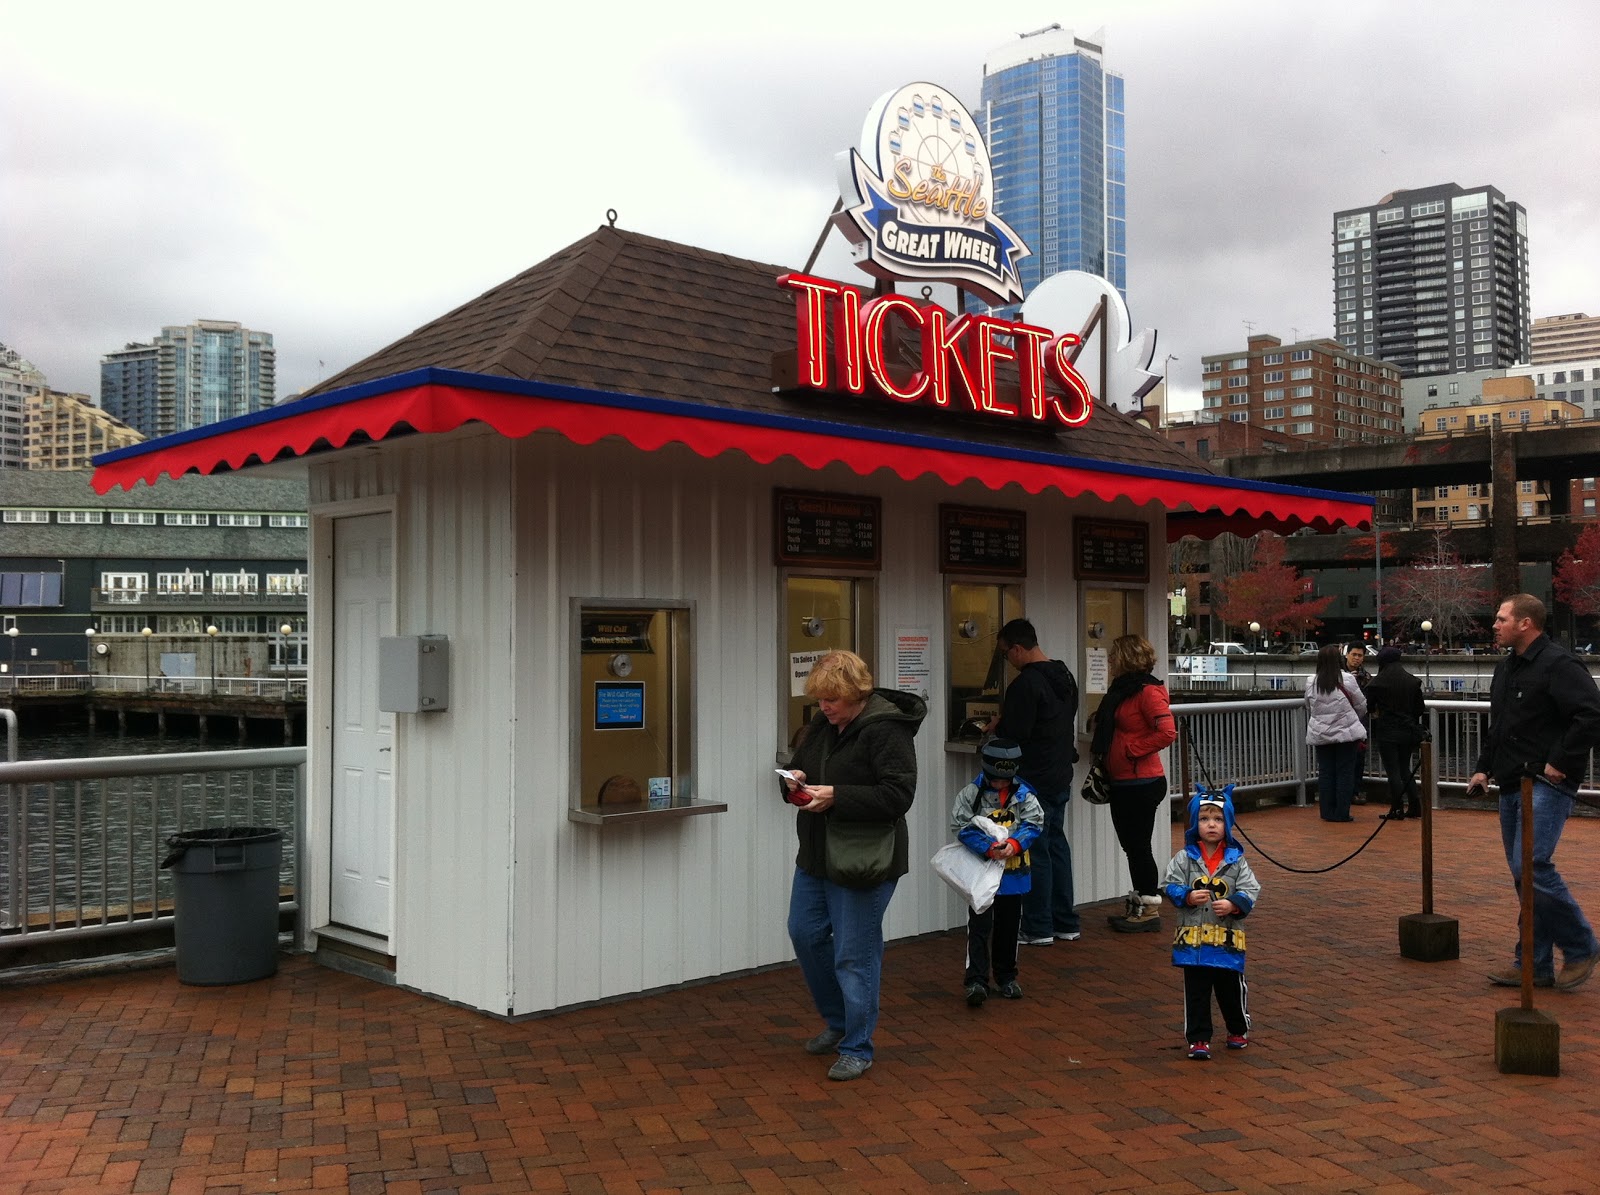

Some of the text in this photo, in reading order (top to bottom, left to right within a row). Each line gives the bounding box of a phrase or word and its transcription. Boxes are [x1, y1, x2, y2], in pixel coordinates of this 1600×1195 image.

[887, 158, 987, 219] Seattle
[931, 163, 947, 182] The
[881, 221, 998, 270] GREAT WHEEL
[777, 273, 1093, 427] TICKETS
[597, 625, 628, 633] Will Call
[615, 636, 633, 644] Sales
